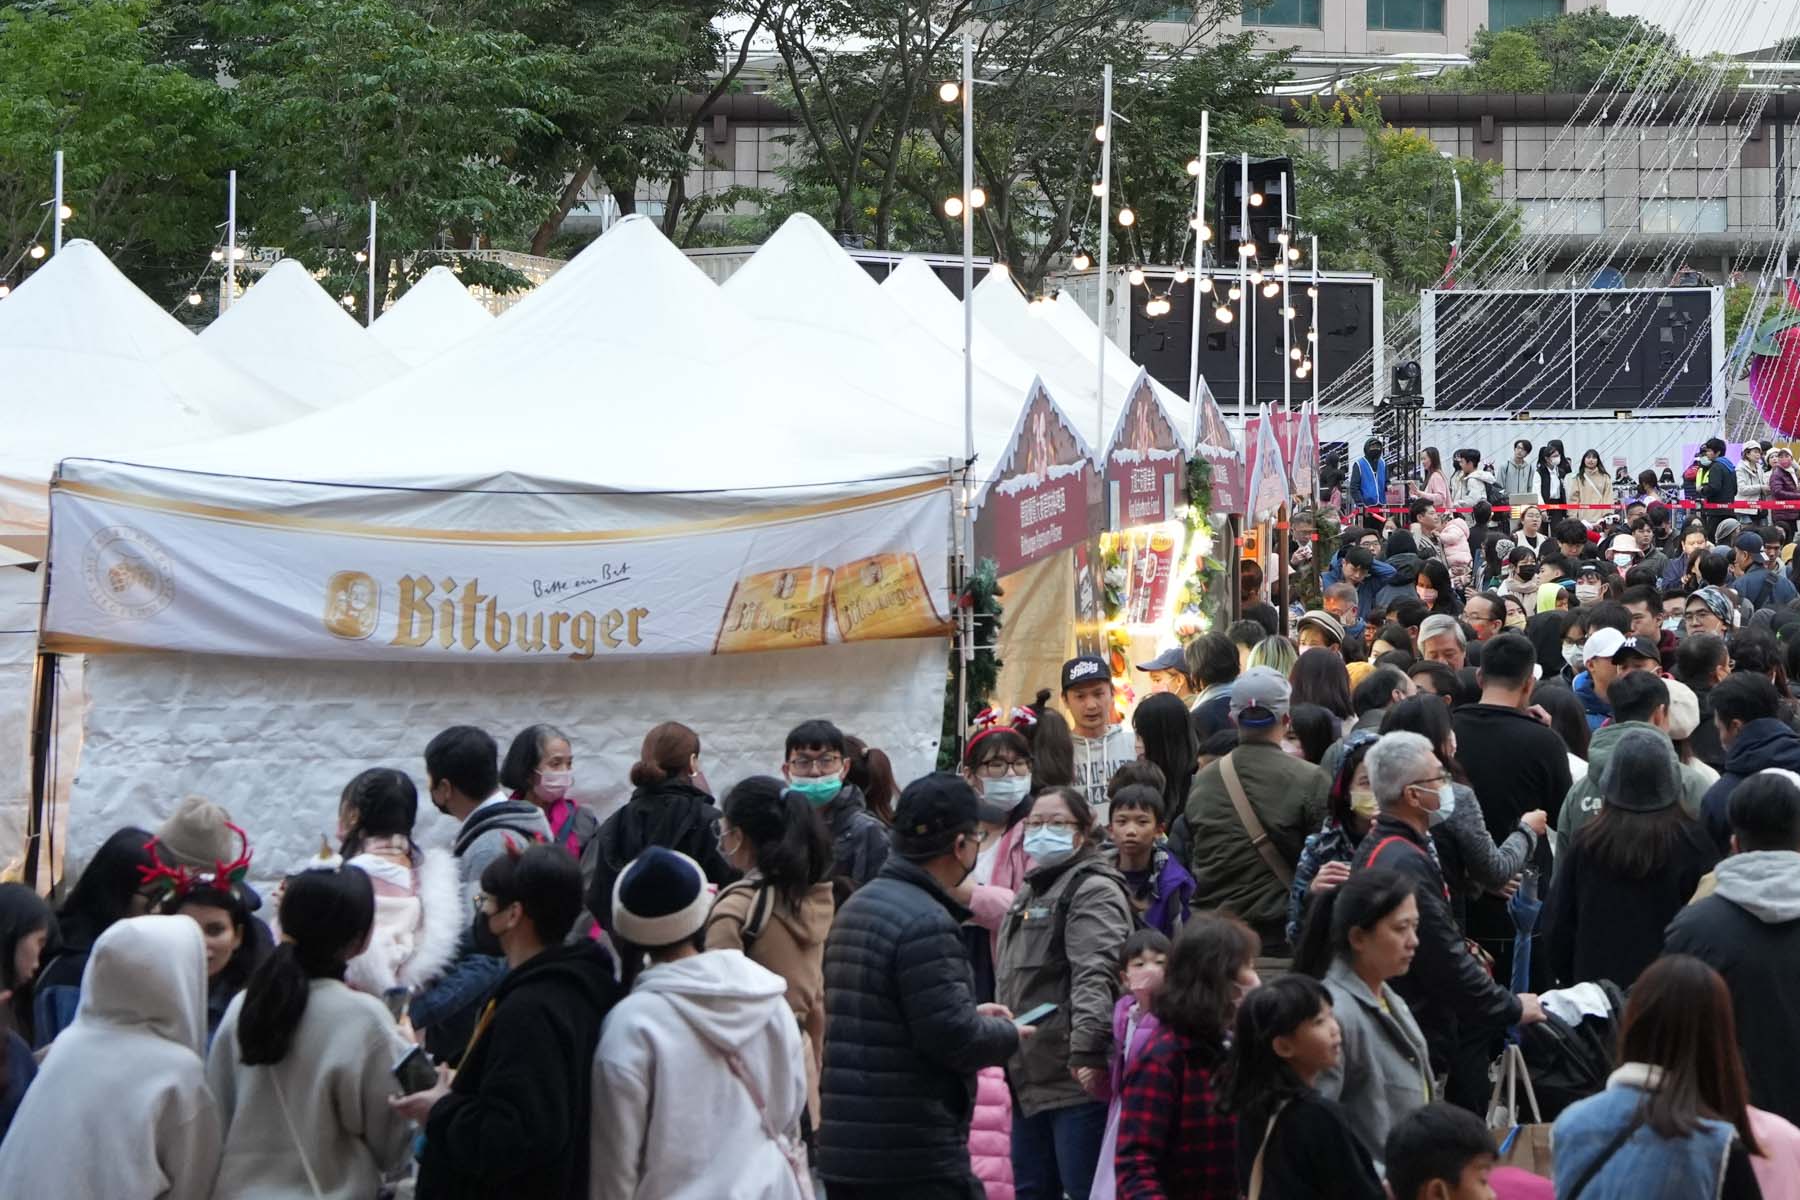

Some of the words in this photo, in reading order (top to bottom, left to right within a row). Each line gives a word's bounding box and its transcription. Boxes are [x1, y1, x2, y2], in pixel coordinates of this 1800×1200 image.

[533, 579, 570, 599] Bitte
[601, 562, 632, 580] Bit
[390, 574, 650, 661] Bitburger
